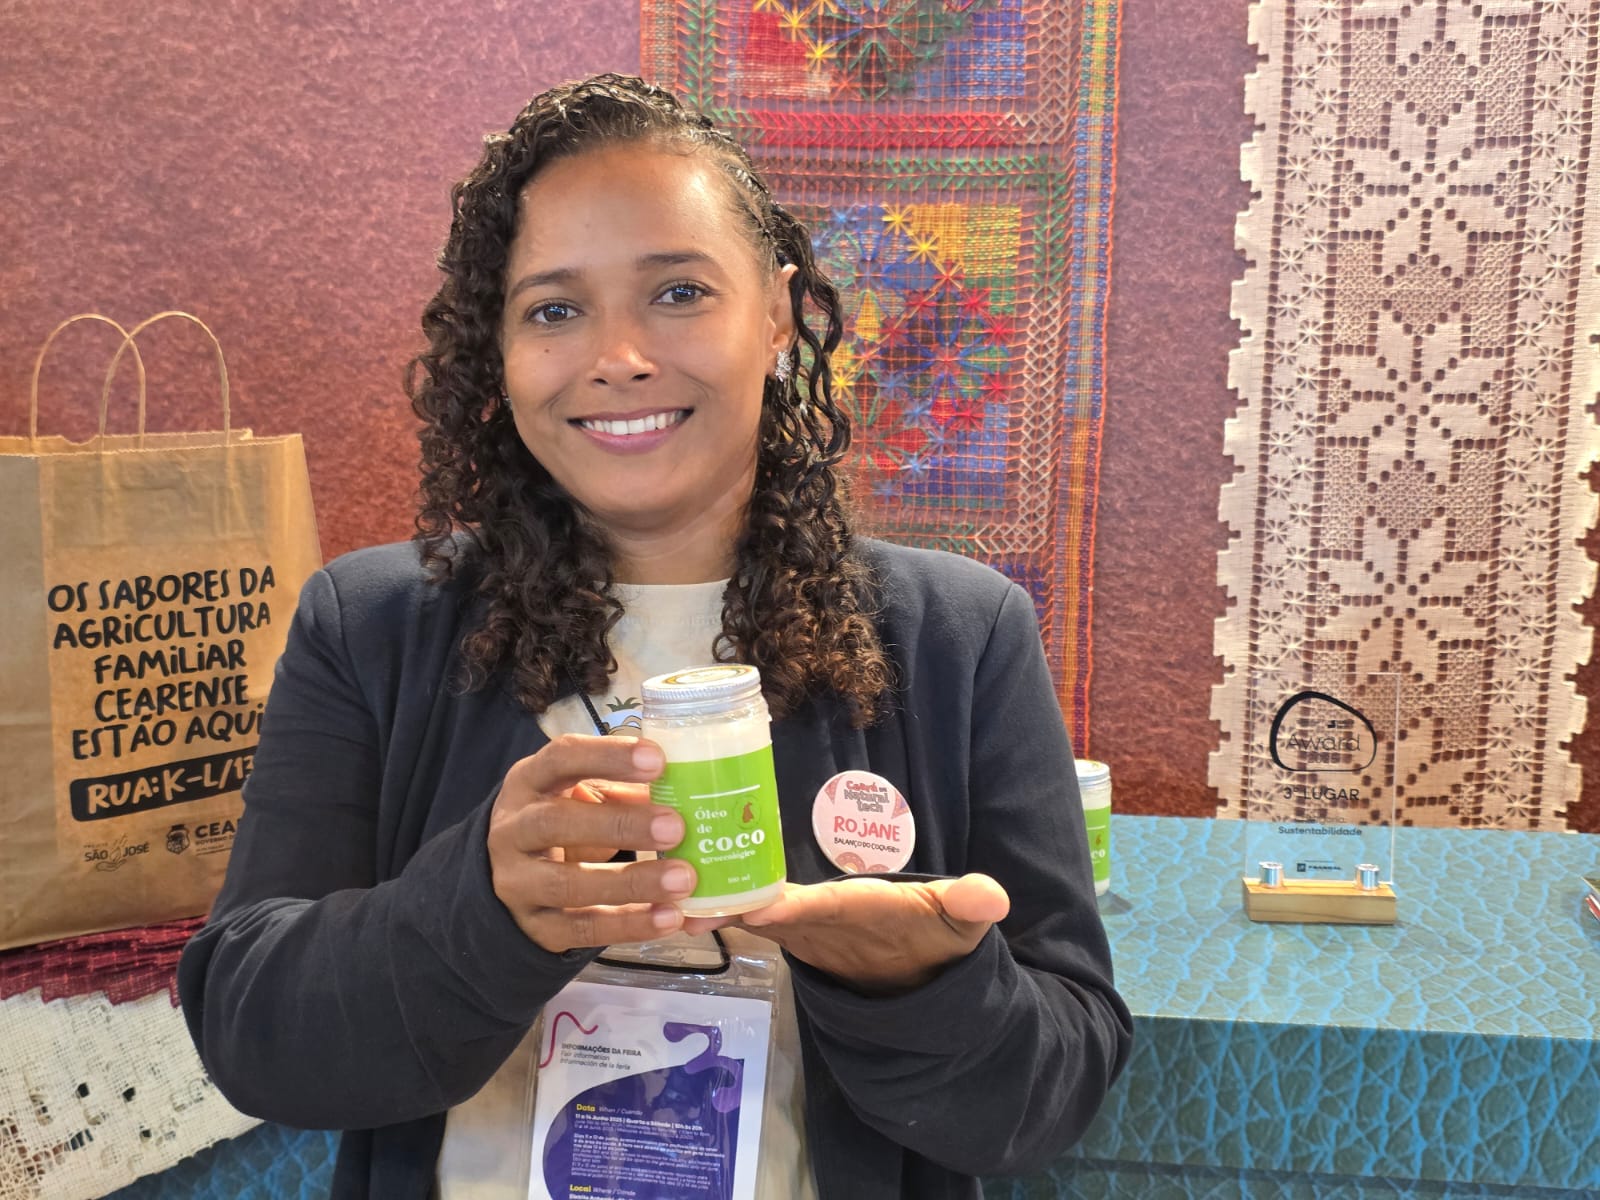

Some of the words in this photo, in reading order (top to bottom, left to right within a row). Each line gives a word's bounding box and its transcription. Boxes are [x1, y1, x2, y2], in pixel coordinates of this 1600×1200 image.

[48, 582, 89, 612] OS
[99, 569, 231, 611] SABORES
[239, 566, 275, 596] DA
[95, 675, 249, 722] CEARENSE
[72, 715, 177, 760] ESTÃO
[1286, 734, 1361, 751] Award
[844, 789, 890, 803] Natural
[1304, 788, 1360, 800] LUGAR
[695, 806, 727, 820] Óleo
[195, 819, 240, 838] CEA
[697, 824, 712, 833] de
[1279, 826, 1362, 836] Sustentabilidade
[698, 829, 765, 854] coco
[85, 849, 108, 862] SÃO
[122, 841, 149, 857] JOSÉ
[576, 1104, 596, 1112] Data
[569, 1184, 591, 1192] Local
